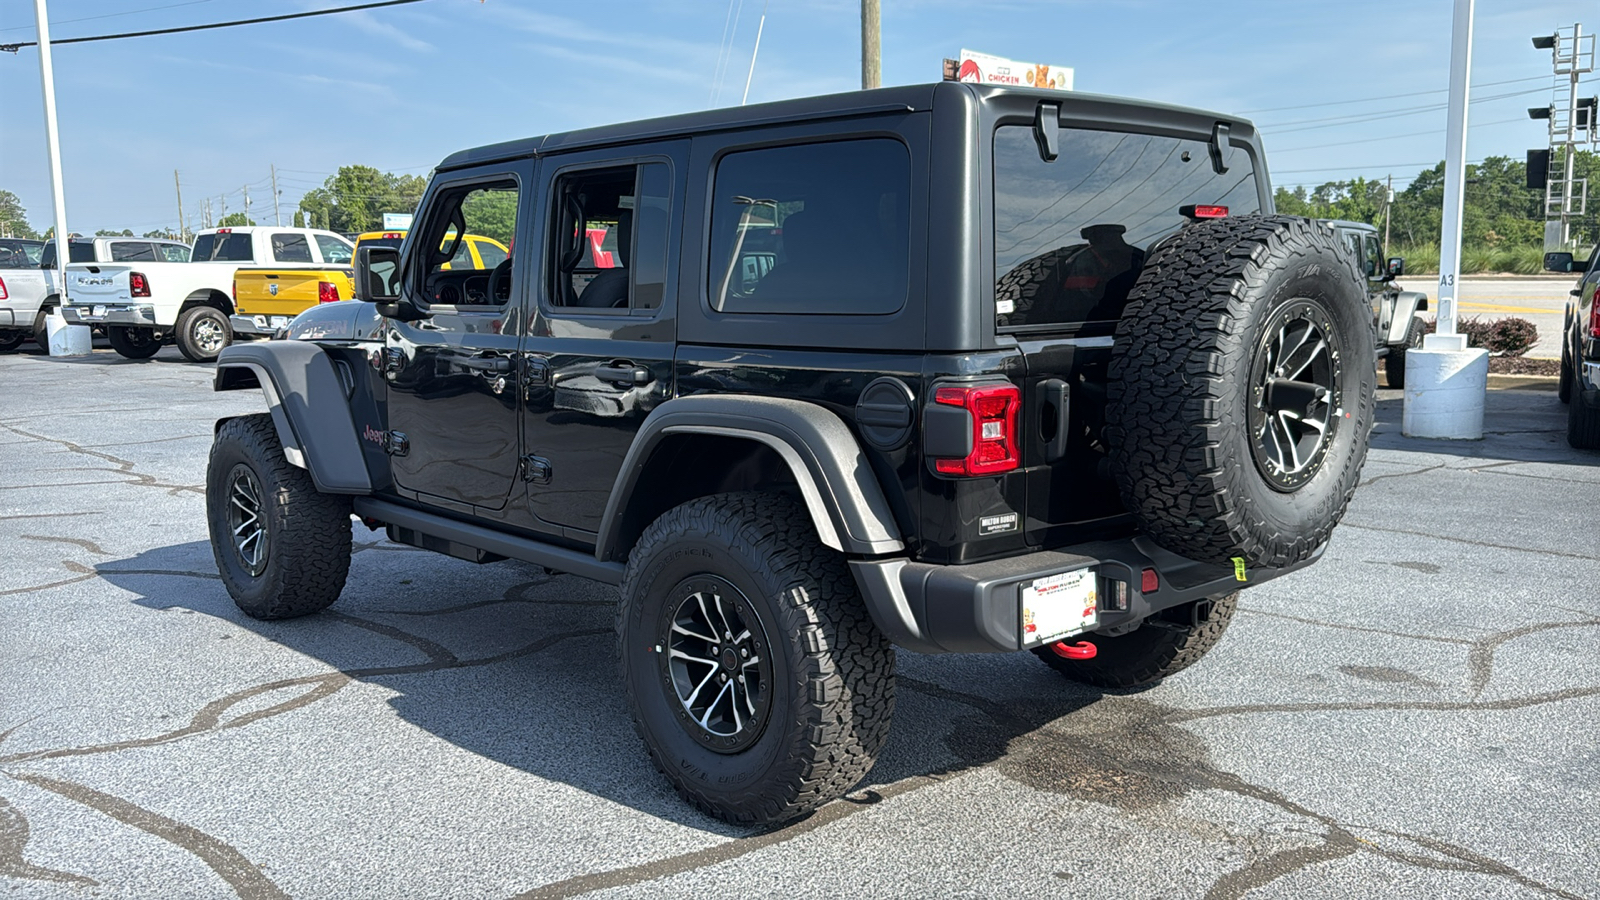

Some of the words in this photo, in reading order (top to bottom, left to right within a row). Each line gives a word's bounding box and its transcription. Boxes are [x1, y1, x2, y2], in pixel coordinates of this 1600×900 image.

[988, 73, 1020, 84] CHICKEN
[1440, 274, 1454, 286] A3
[363, 424, 384, 447] Jeep
[981, 516, 1000, 527] MILTON
